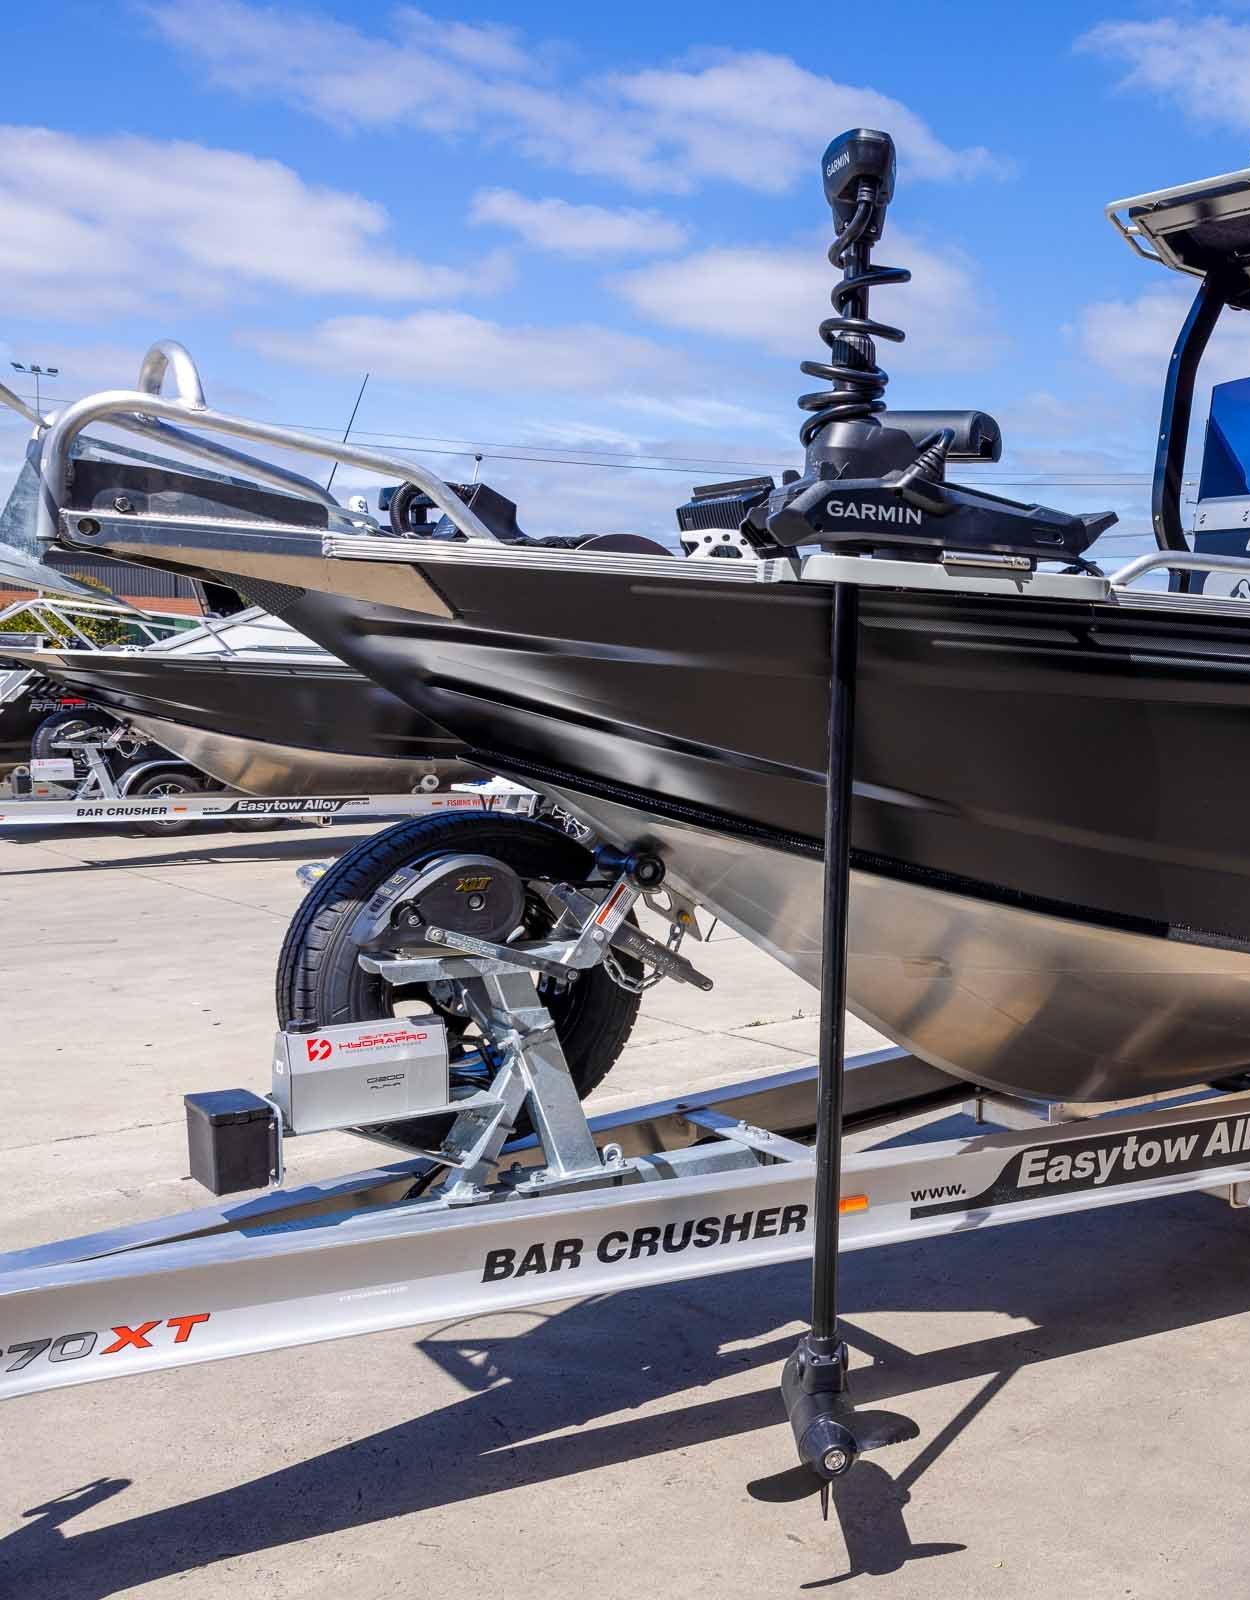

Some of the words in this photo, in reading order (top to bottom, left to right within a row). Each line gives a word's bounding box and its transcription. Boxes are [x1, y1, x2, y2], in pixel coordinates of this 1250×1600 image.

[826, 151, 850, 177] GARMIN
[826, 500, 922, 525] GARMIN
[77, 808, 103, 816] BAR
[106, 807, 167, 815] CRUSHER
[237, 801, 301, 813] Easytow
[302, 799, 340, 811] Alloy
[338, 1033, 428, 1050] HYDRAPRO
[911, 1182, 966, 1202] www.
[1017, 1133, 1200, 1188] Easytow
[481, 1238, 584, 1284] BAR
[596, 1204, 809, 1264] CRUSHER
[0, 1313, 210, 1372] 70XT
